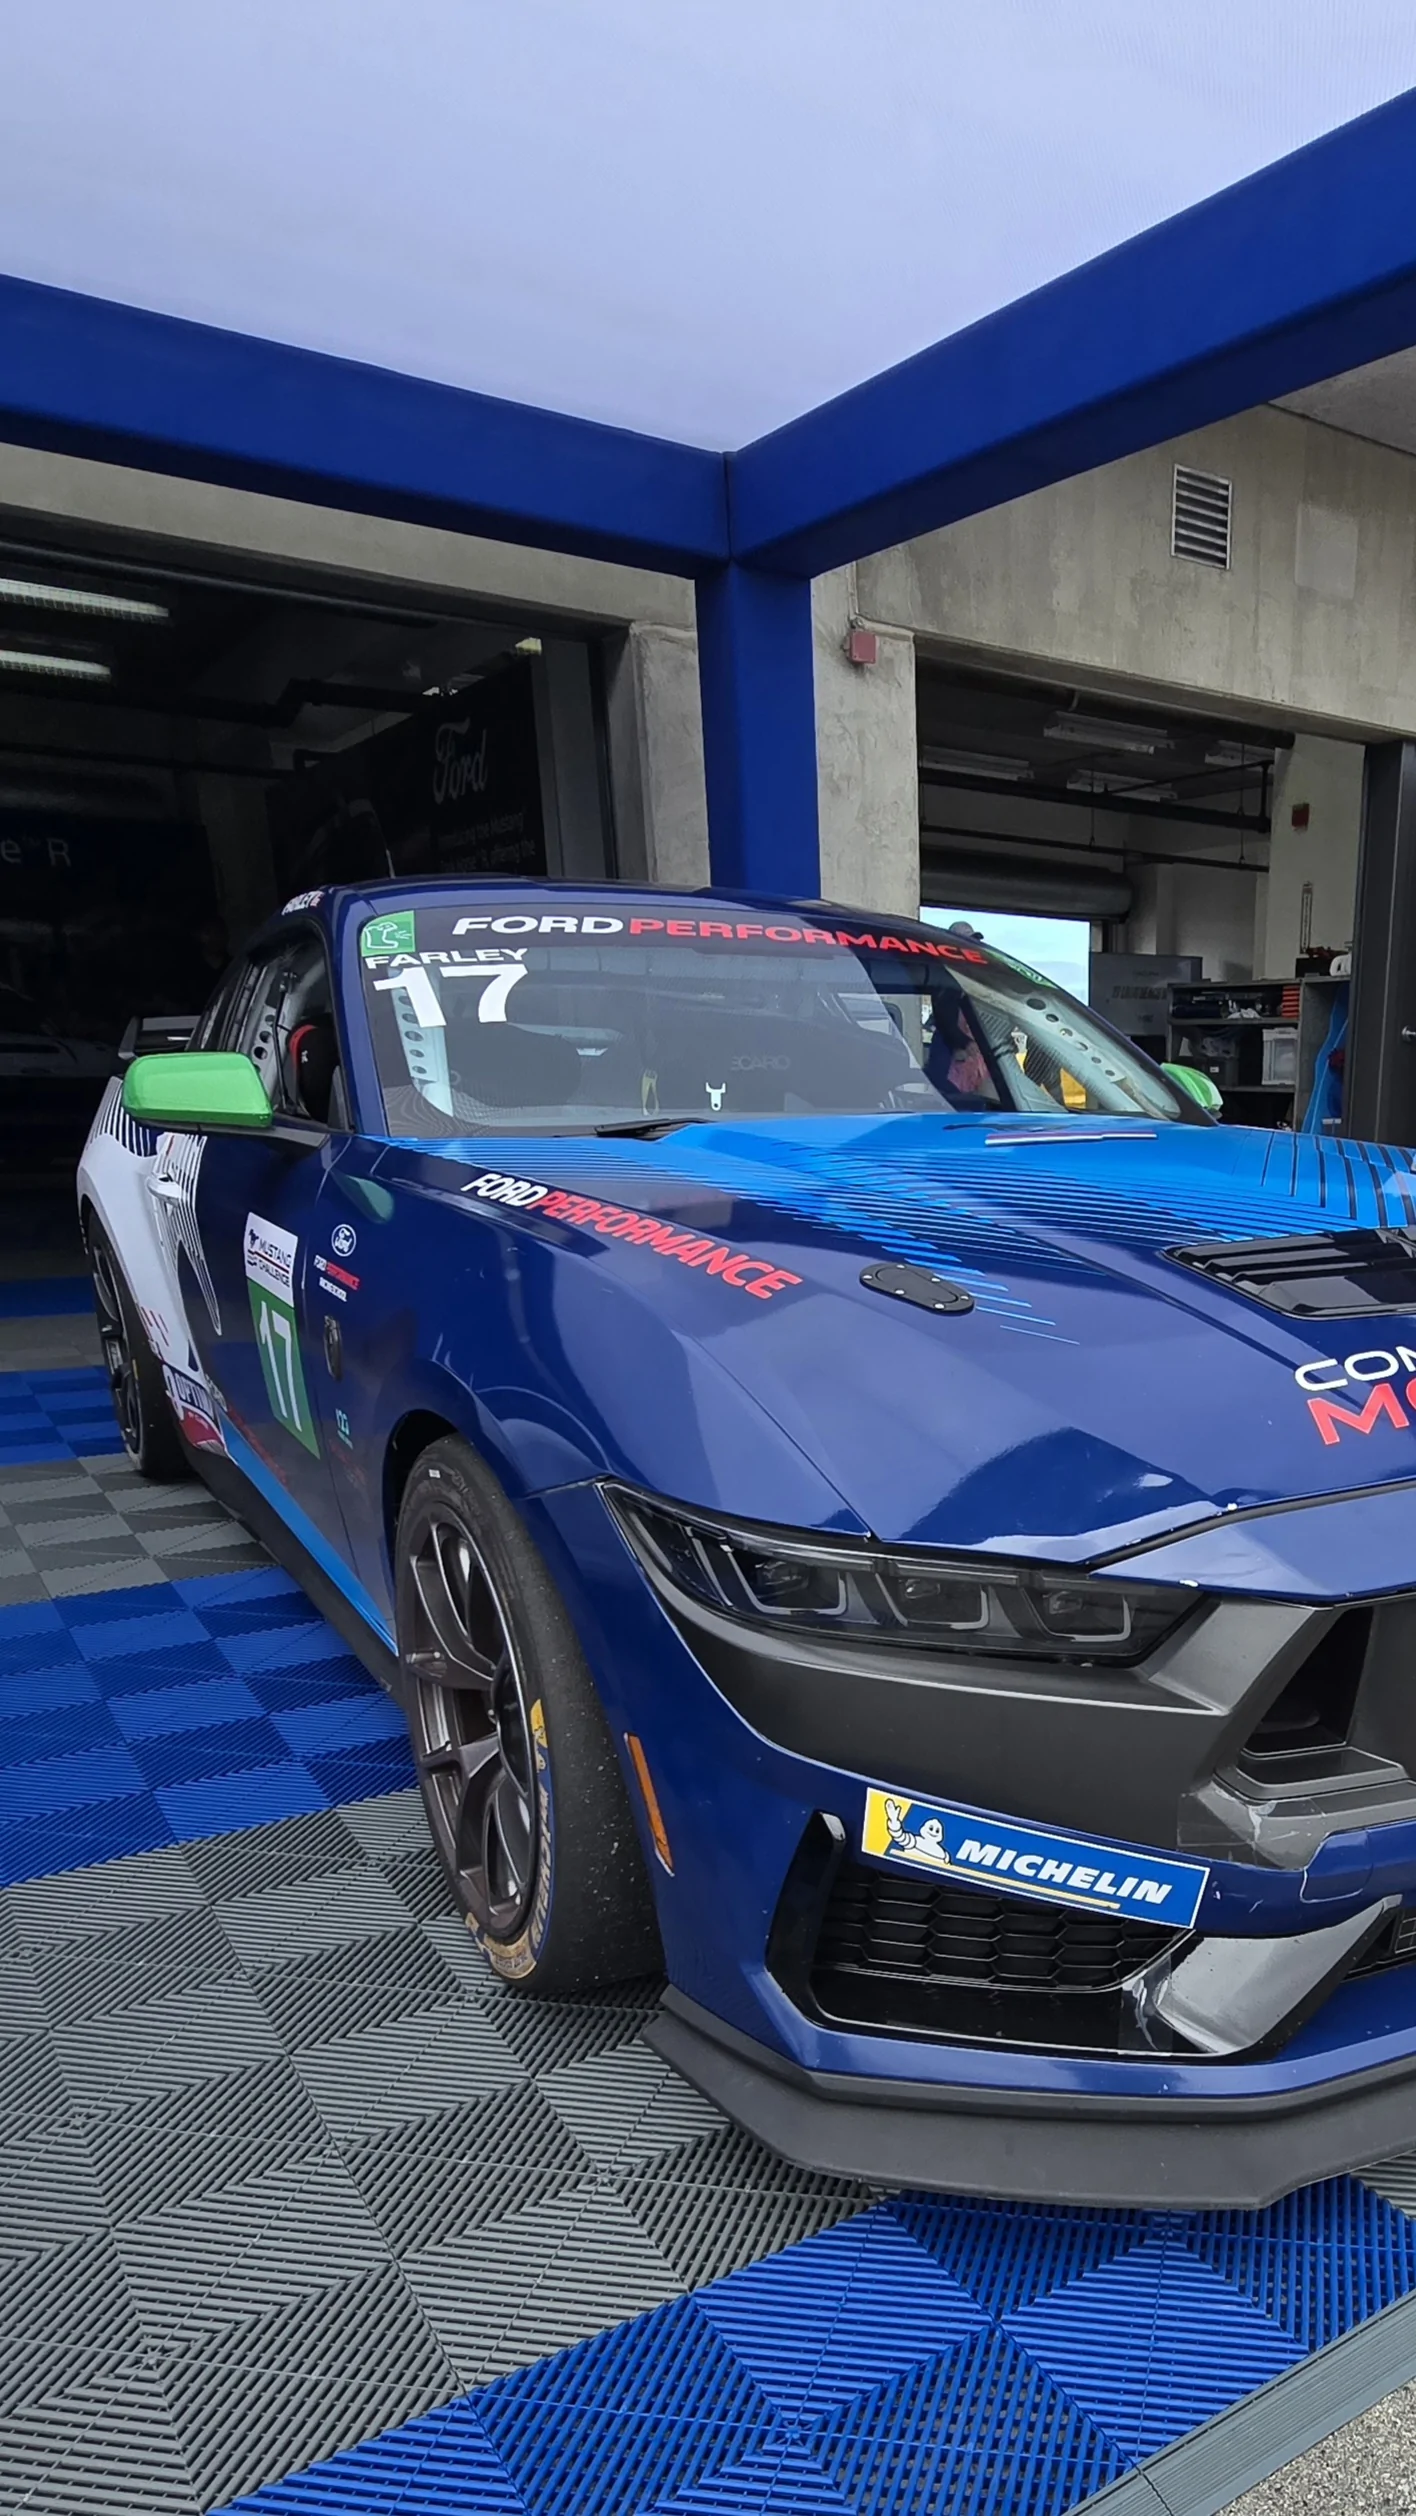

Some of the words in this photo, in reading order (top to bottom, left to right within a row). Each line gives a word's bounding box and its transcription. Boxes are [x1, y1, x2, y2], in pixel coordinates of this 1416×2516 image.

[432, 715, 488, 805] Ford
[365, 947, 529, 970] FARLEY
[629, 917, 988, 965] PERFORMANCE
[373, 963, 529, 1029] 17
[258, 1259, 291, 1288] CHALLENGE
[259, 1237, 292, 1268] MUSTANG
[526, 1190, 803, 1300] PERFORMANCE
[259, 1300, 303, 1433] 17
[955, 1837, 1173, 1906] MICHELIN
